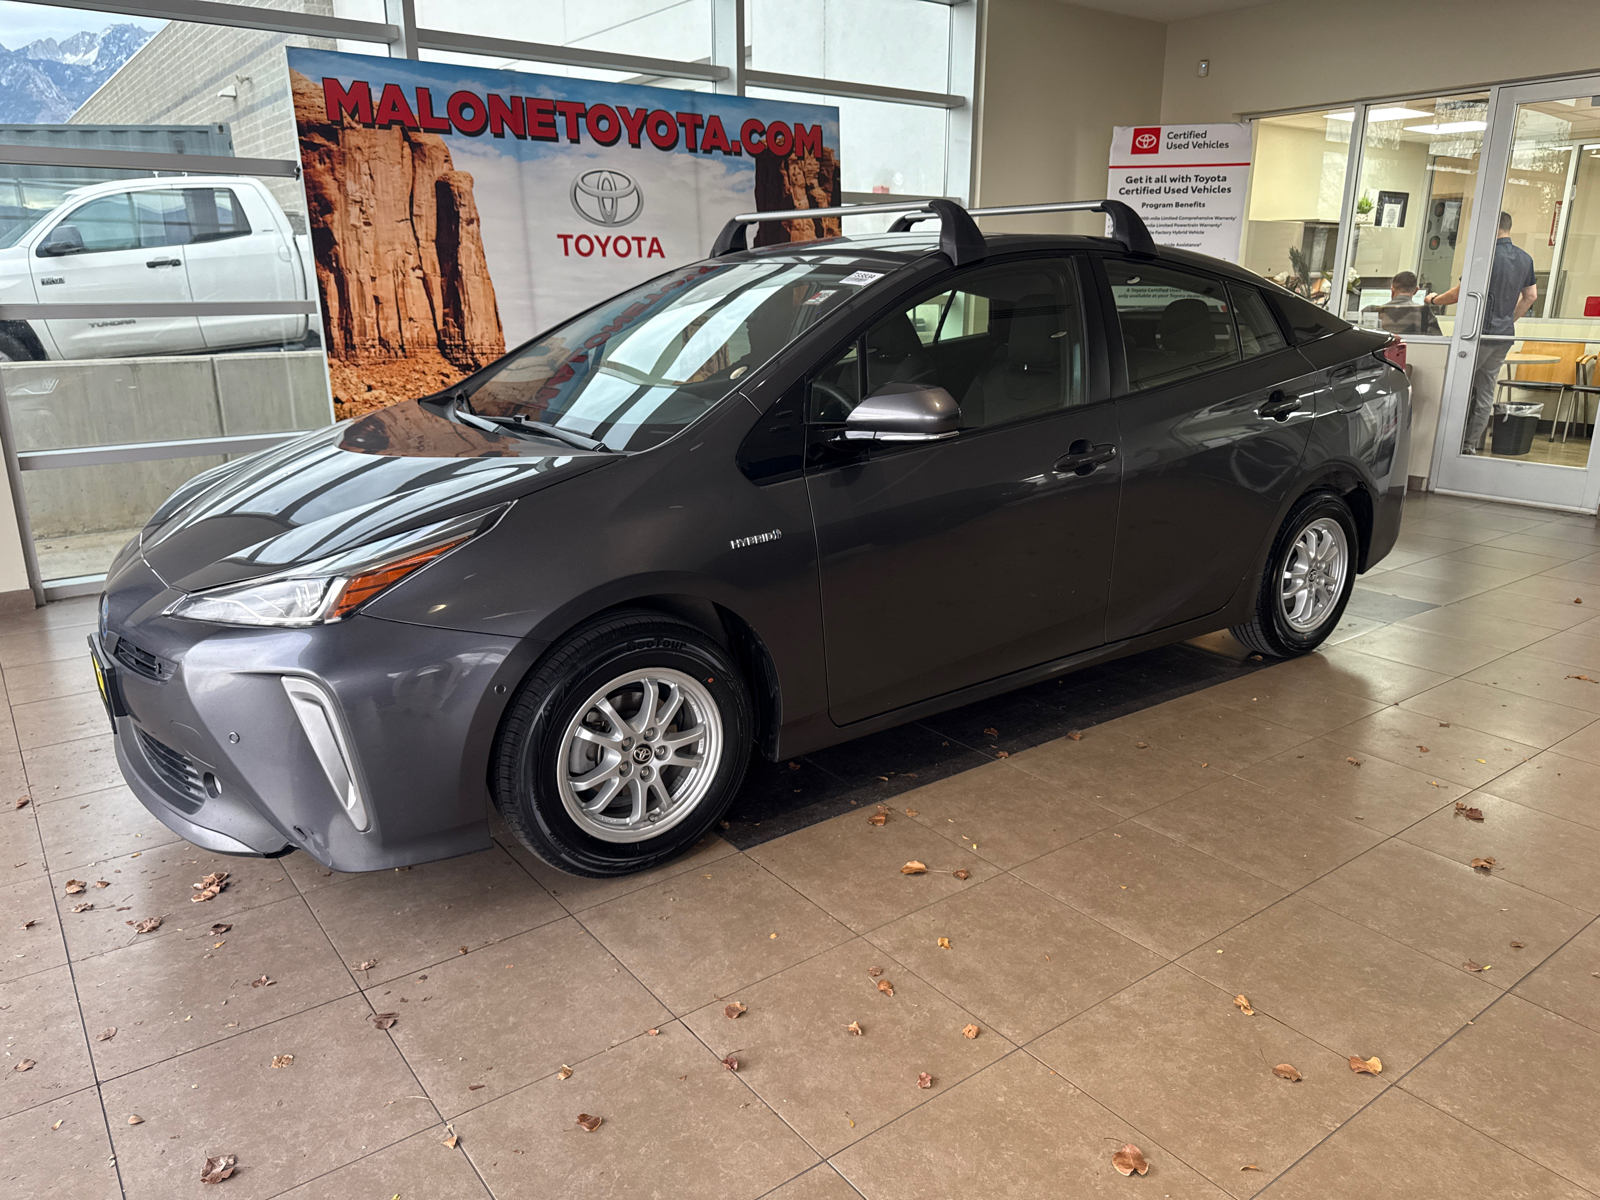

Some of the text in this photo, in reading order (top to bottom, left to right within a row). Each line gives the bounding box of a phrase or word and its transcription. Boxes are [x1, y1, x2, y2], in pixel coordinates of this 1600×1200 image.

[322, 77, 824, 161] MALONETOYOTA.COM
[1166, 130, 1208, 140] Certified
[1166, 140, 1230, 150] Used Vehicles
[1125, 174, 1227, 184] Get it all with Toyota
[1118, 185, 1232, 196] Certified Used Vehicles
[1141, 201, 1206, 210] Program Benefits
[556, 233, 666, 259] TOYOTA
[730, 532, 773, 549] HYBRID
